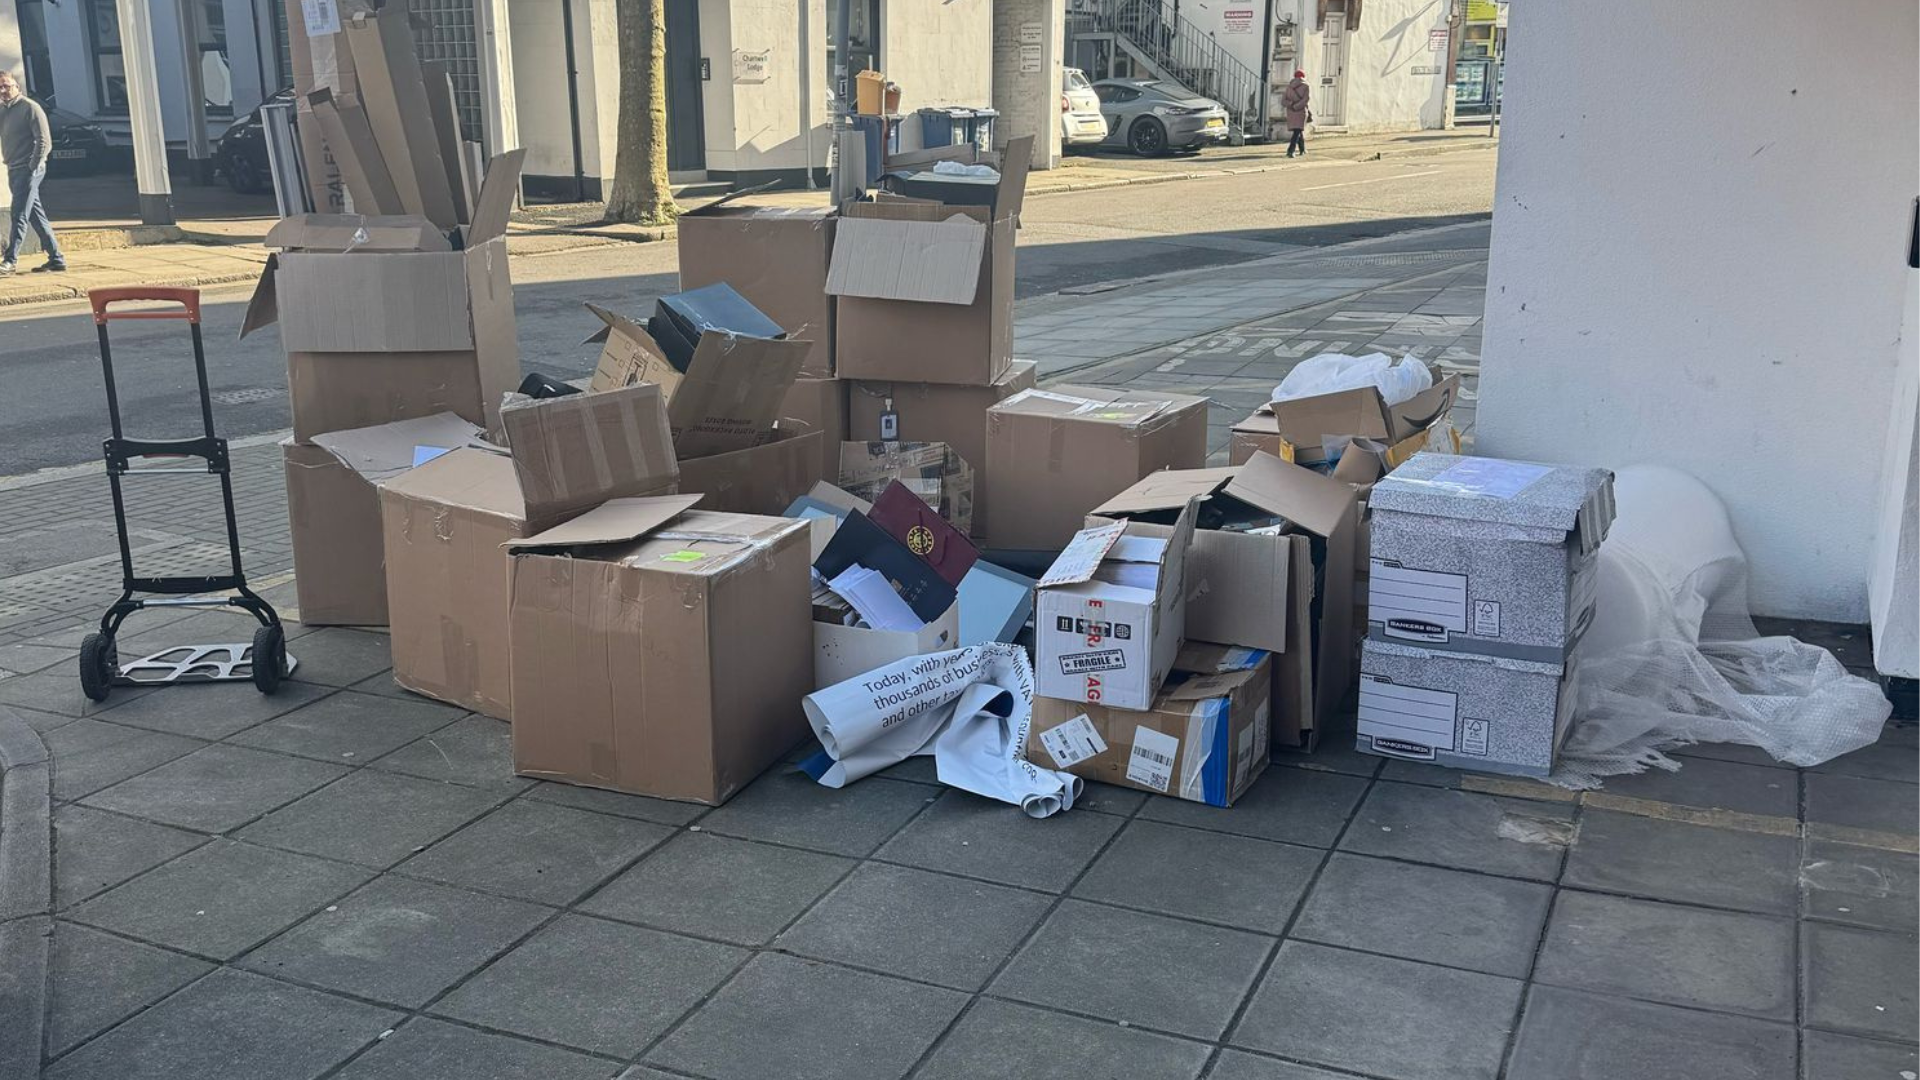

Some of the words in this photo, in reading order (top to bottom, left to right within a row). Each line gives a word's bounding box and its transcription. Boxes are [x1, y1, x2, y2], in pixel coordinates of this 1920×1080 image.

[1389, 620, 1425, 631] BANKERS
[1426, 625, 1443, 633] BOX
[1073, 655, 1112, 669] FRAGILE
[862, 671, 912, 693] Today,
[911, 657, 941, 675] with
[873, 676, 941, 710] thousands
[882, 706, 905, 728] and
[908, 695, 941, 717] other
[1376, 739, 1412, 750] BANKERS
